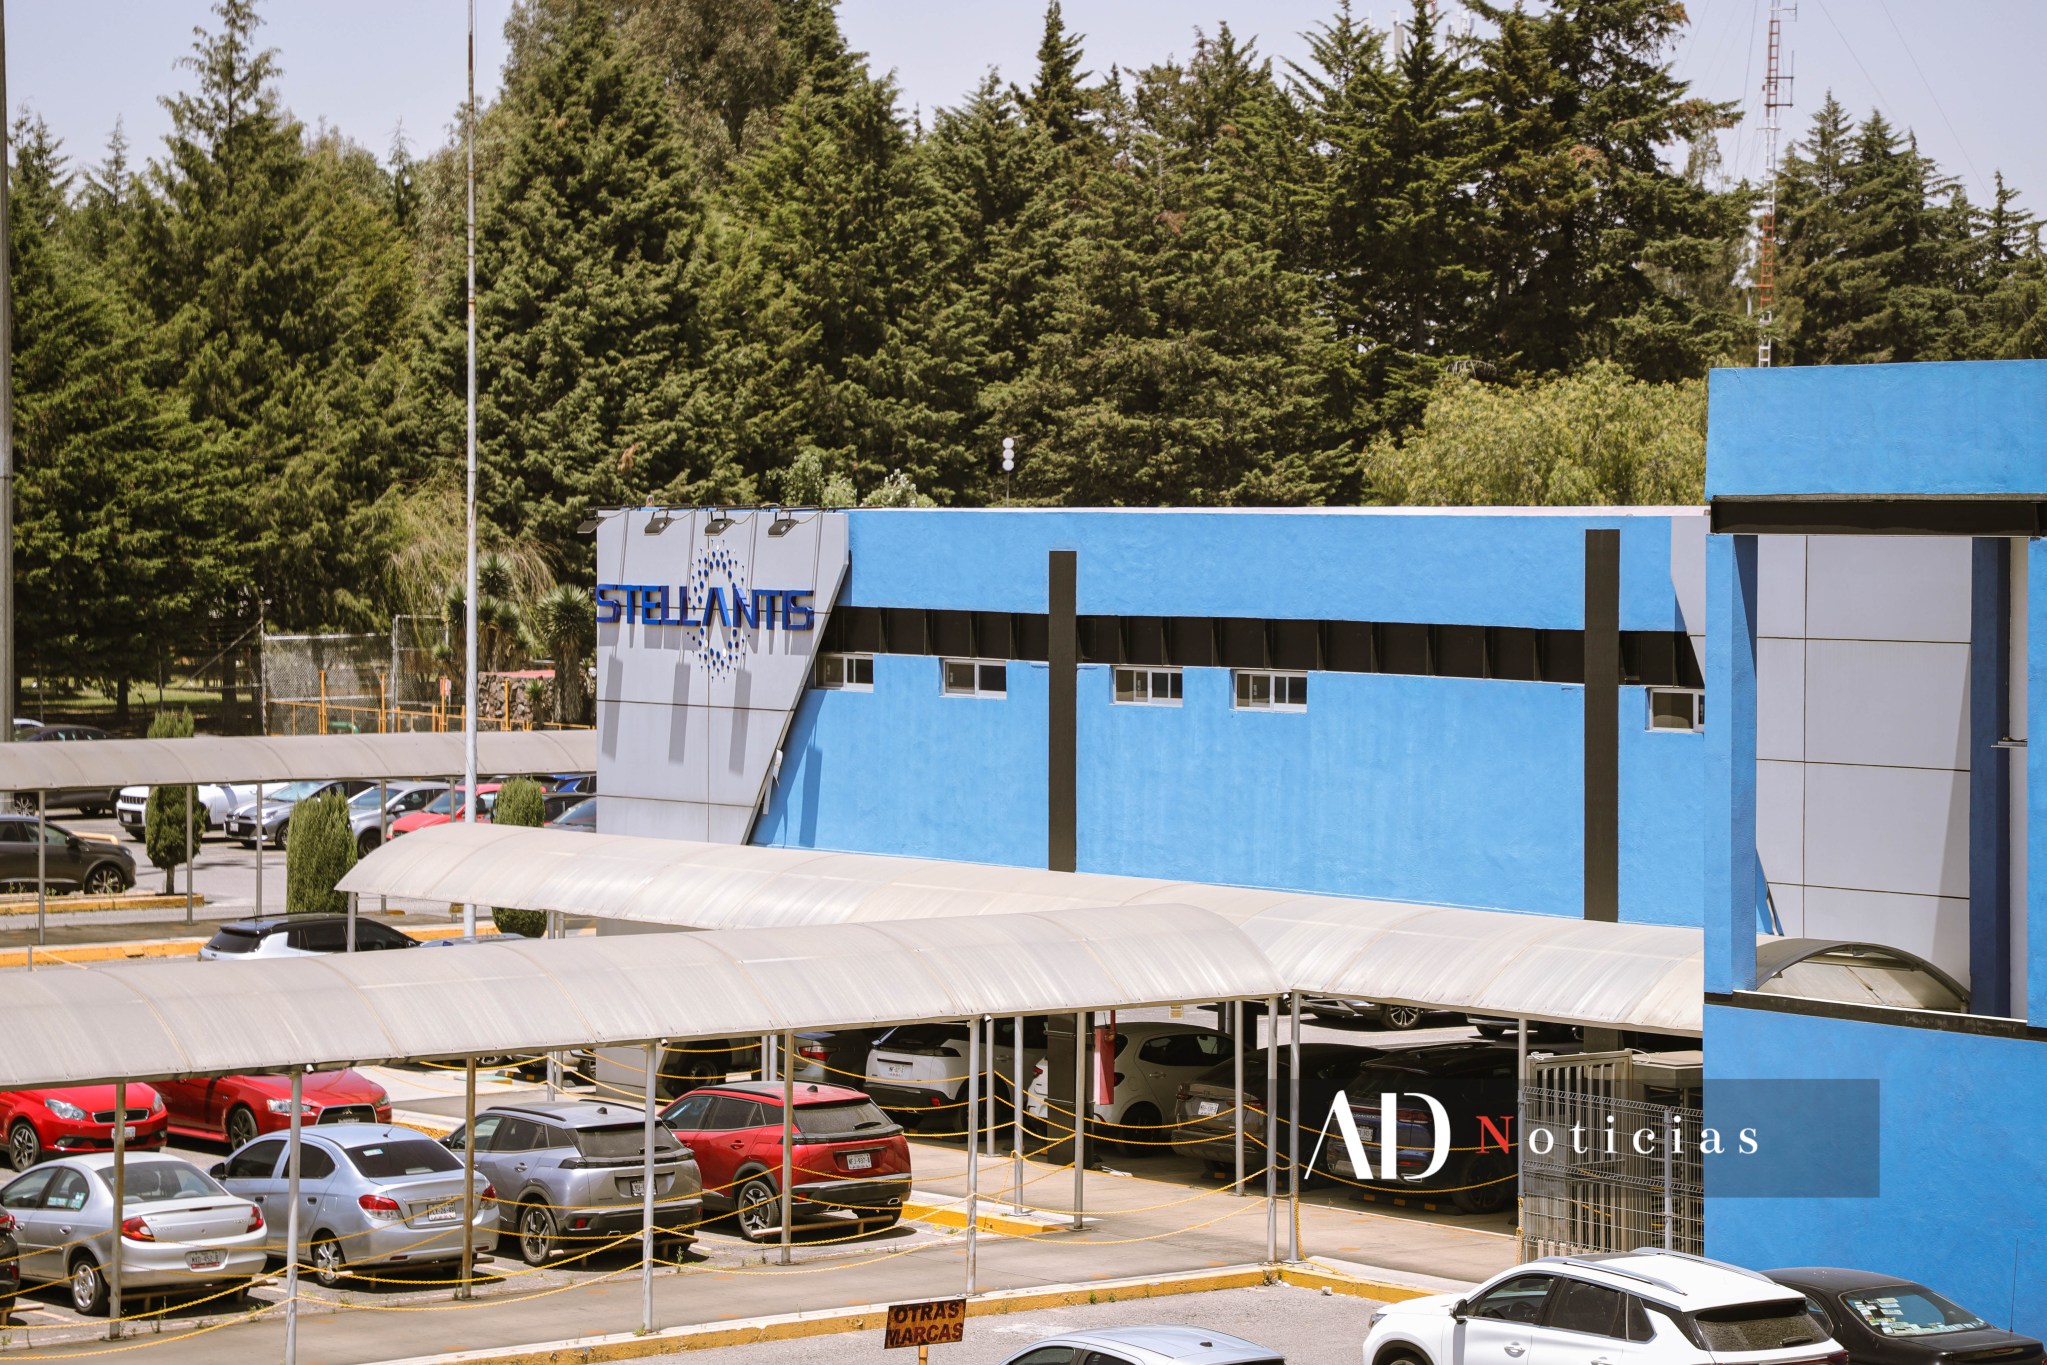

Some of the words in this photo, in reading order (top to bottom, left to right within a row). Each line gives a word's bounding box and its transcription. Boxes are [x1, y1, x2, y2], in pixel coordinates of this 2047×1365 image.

[596, 584, 814, 630] STELLANTIS
[893, 1300, 960, 1323] OTRAS
[886, 1323, 964, 1346] MARCAS
